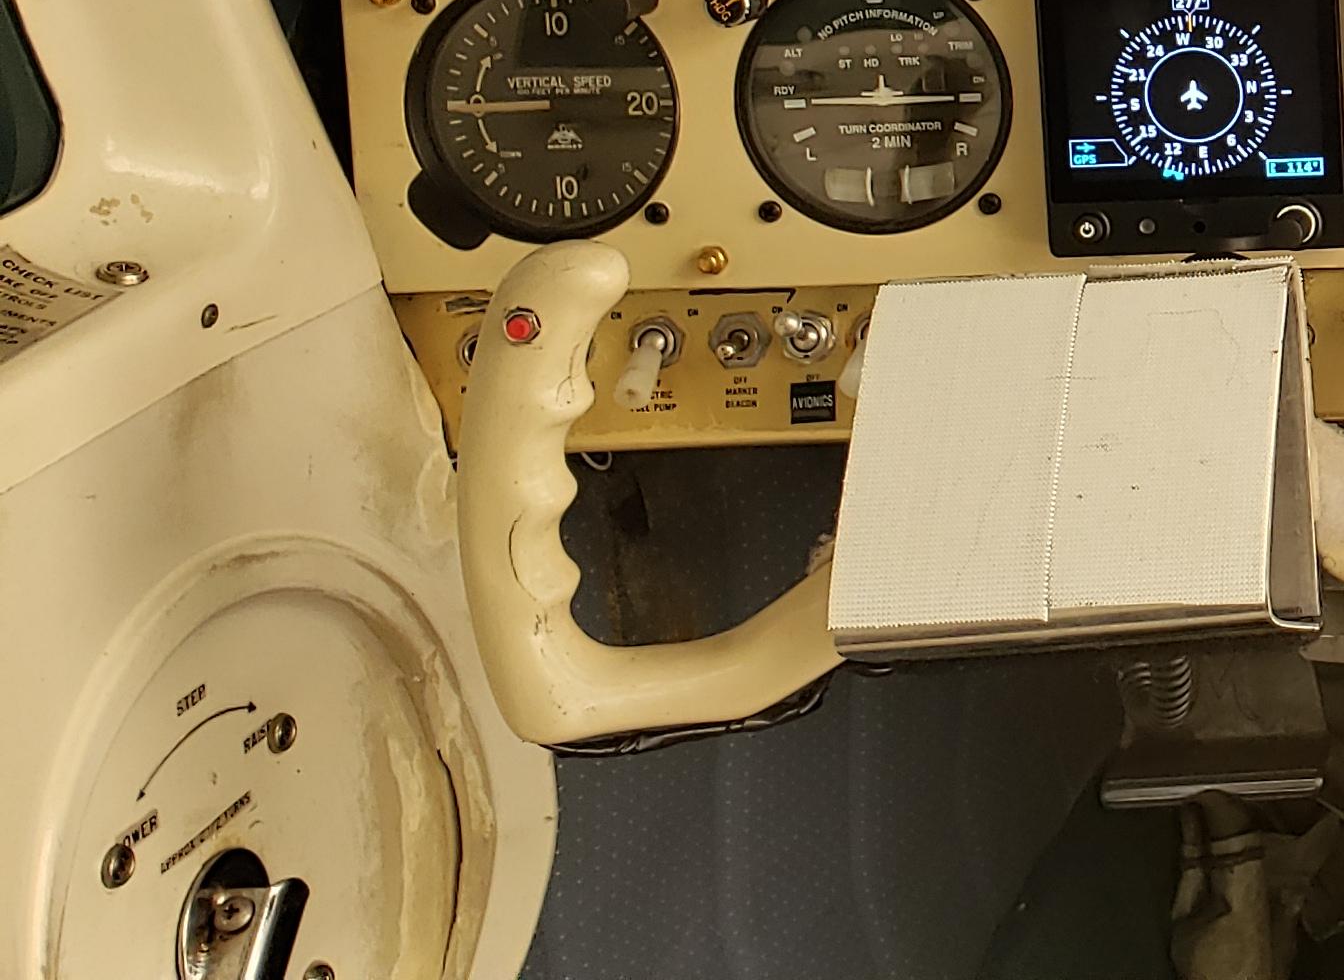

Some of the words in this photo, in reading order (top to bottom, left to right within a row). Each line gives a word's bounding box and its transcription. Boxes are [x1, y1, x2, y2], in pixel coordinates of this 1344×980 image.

[543, 11, 569, 37] 10
[507, 75, 565, 89] VERTICAL
[573, 75, 612, 88] SPEED
[626, 92, 659, 116] 20
[838, 123, 866, 134] TURN
[868, 121, 942, 133] COORDINATOR
[872, 136, 881, 149] 2
[883, 134, 911, 148] MIN
[1074, 154, 1096, 165] GPS
[555, 175, 579, 200] 10
[792, 395, 833, 410] AVIONICS
